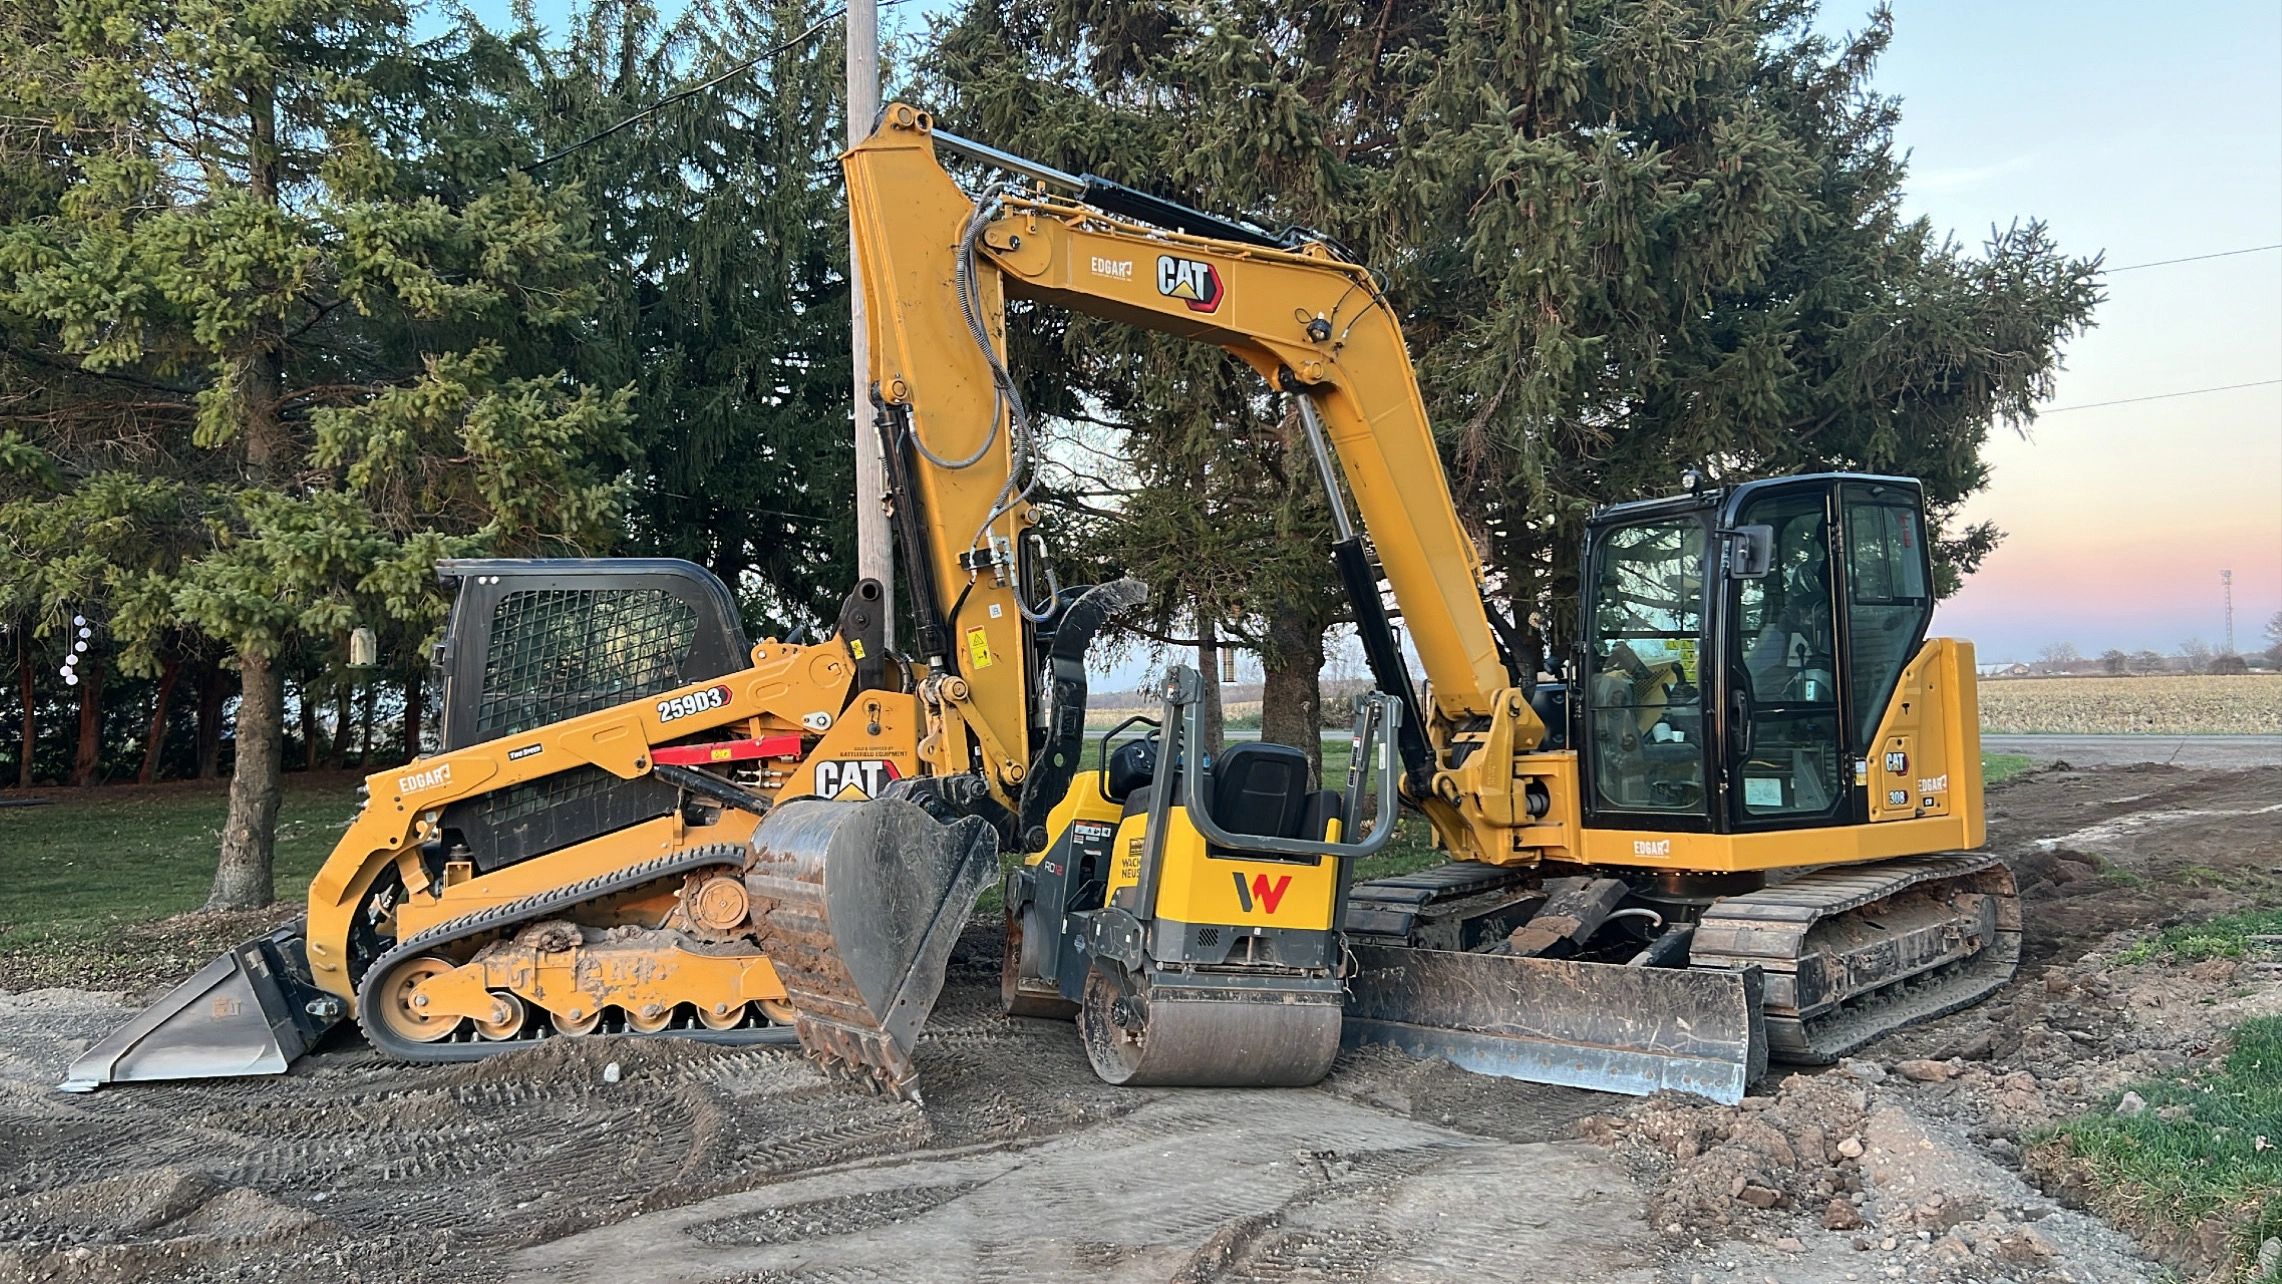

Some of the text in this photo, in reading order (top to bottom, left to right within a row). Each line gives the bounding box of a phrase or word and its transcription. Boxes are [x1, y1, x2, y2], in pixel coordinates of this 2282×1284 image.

[1091, 256, 1128, 277] EDGAR
[1157, 255, 1209, 301] CAT
[657, 687, 723, 723] 259D3
[1885, 752, 1905, 771] CAT
[398, 766, 448, 793] EDGAR
[815, 760, 883, 800] CAT
[1918, 776, 1945, 792] EDGAR
[1889, 790, 1906, 804] 308
[1633, 840, 1667, 856] EDGAR
